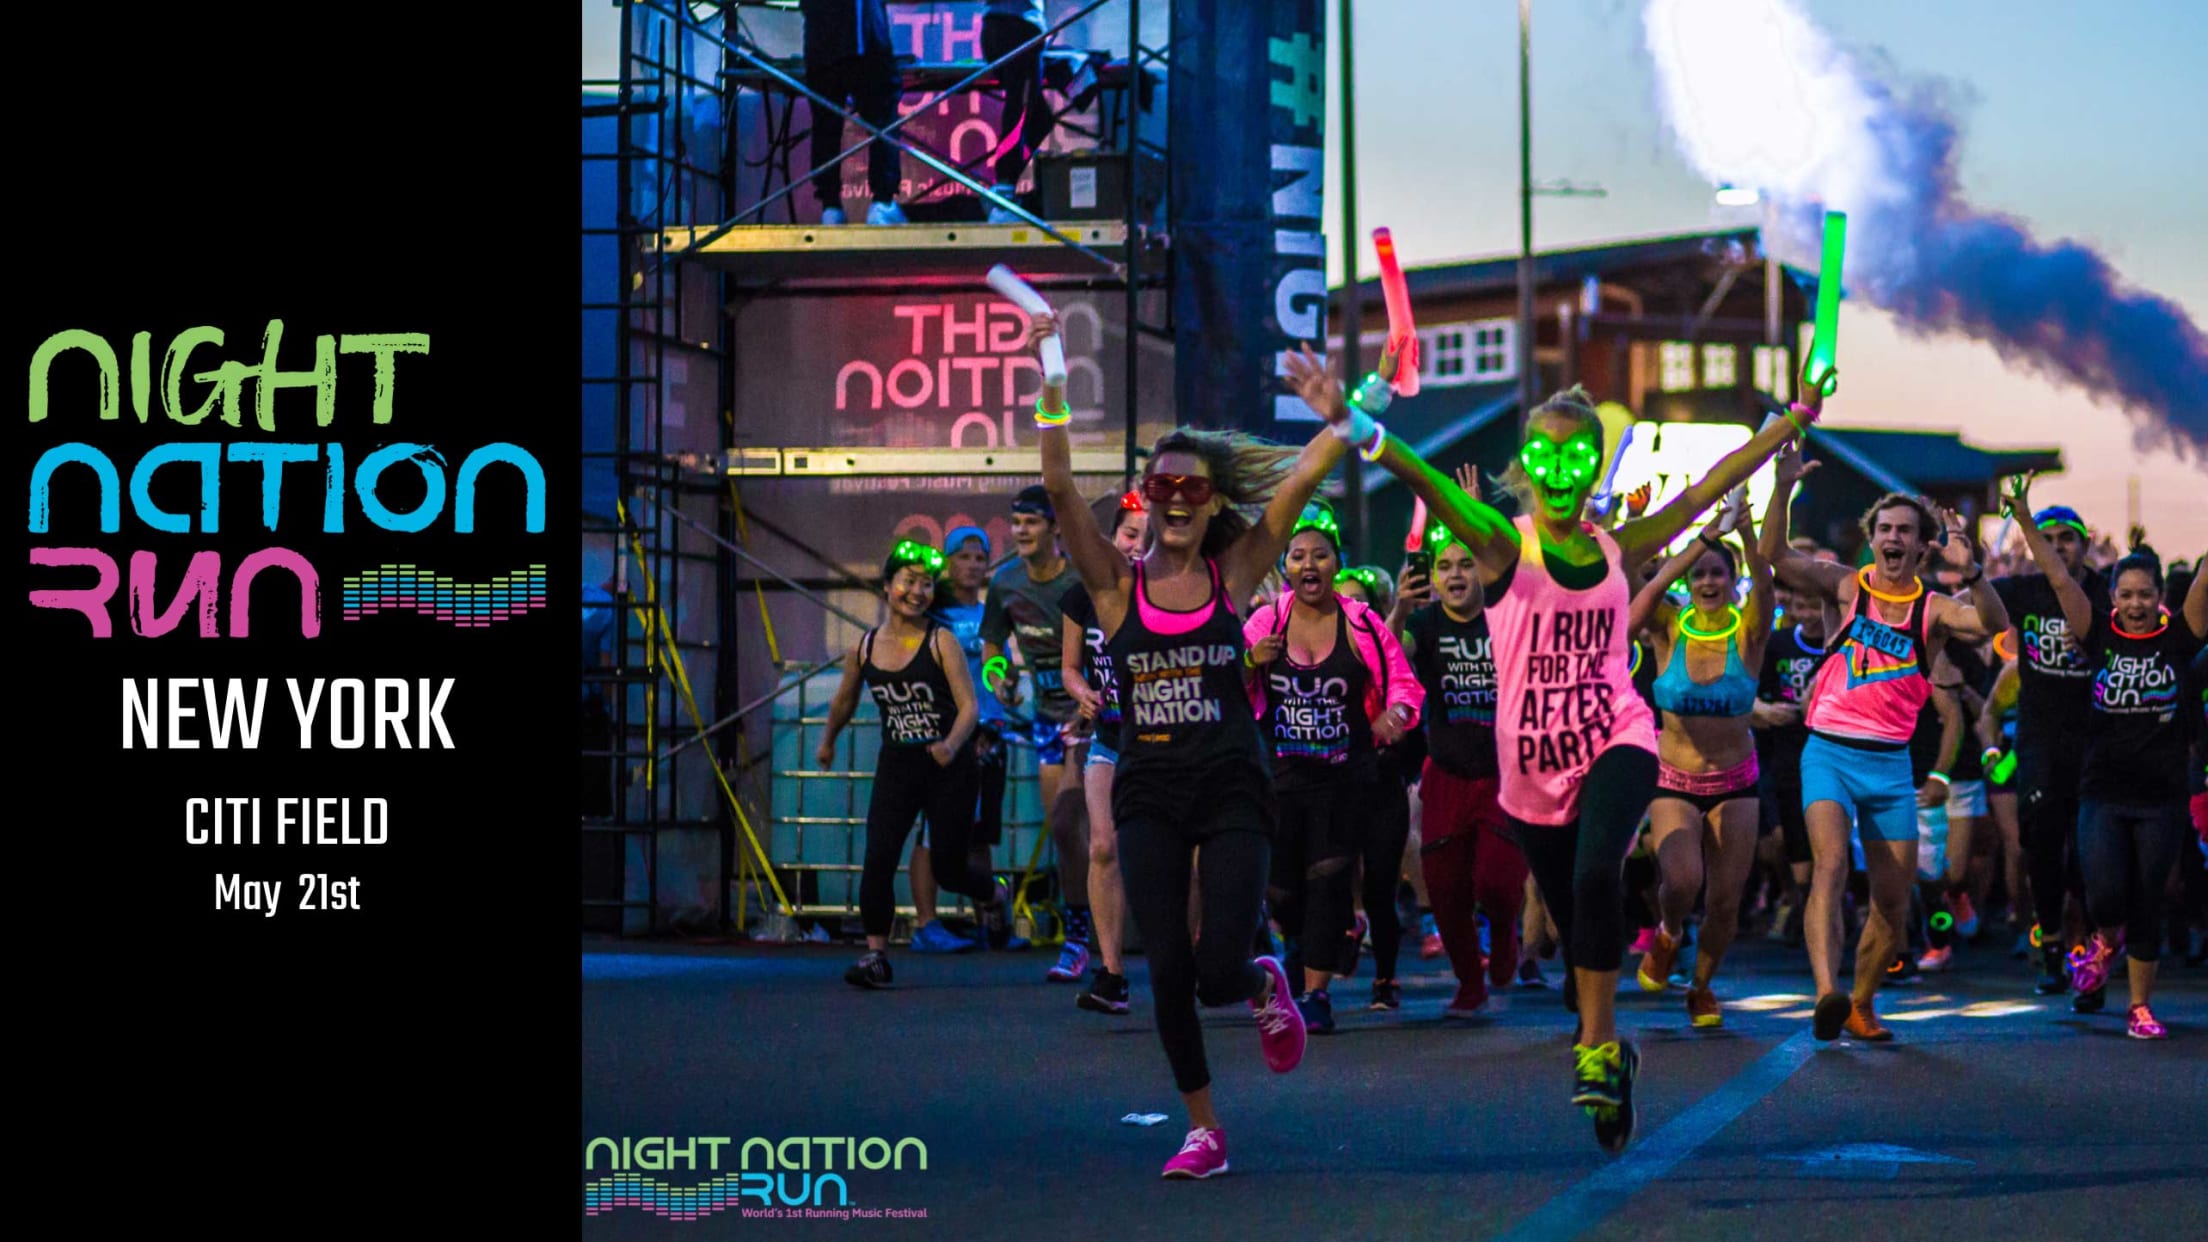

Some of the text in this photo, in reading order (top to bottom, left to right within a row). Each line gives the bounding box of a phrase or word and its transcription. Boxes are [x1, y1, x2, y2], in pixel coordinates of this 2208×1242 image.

[1529, 608, 1615, 653] I RUN
[1127, 644, 1236, 673] STAND UP
[1447, 662, 1479, 672] WITH
[1527, 654, 1570, 684] FOR
[871, 682, 934, 704] RUN
[1132, 676, 1203, 704] NIGHT
[1270, 673, 1349, 698] RUN
[1134, 699, 1222, 726] NATION
[1275, 704, 1346, 726] NIGHT
[1519, 682, 1614, 731] AFTER
[1274, 722, 1349, 740] NATION
[1518, 713, 1615, 775] PARTY
